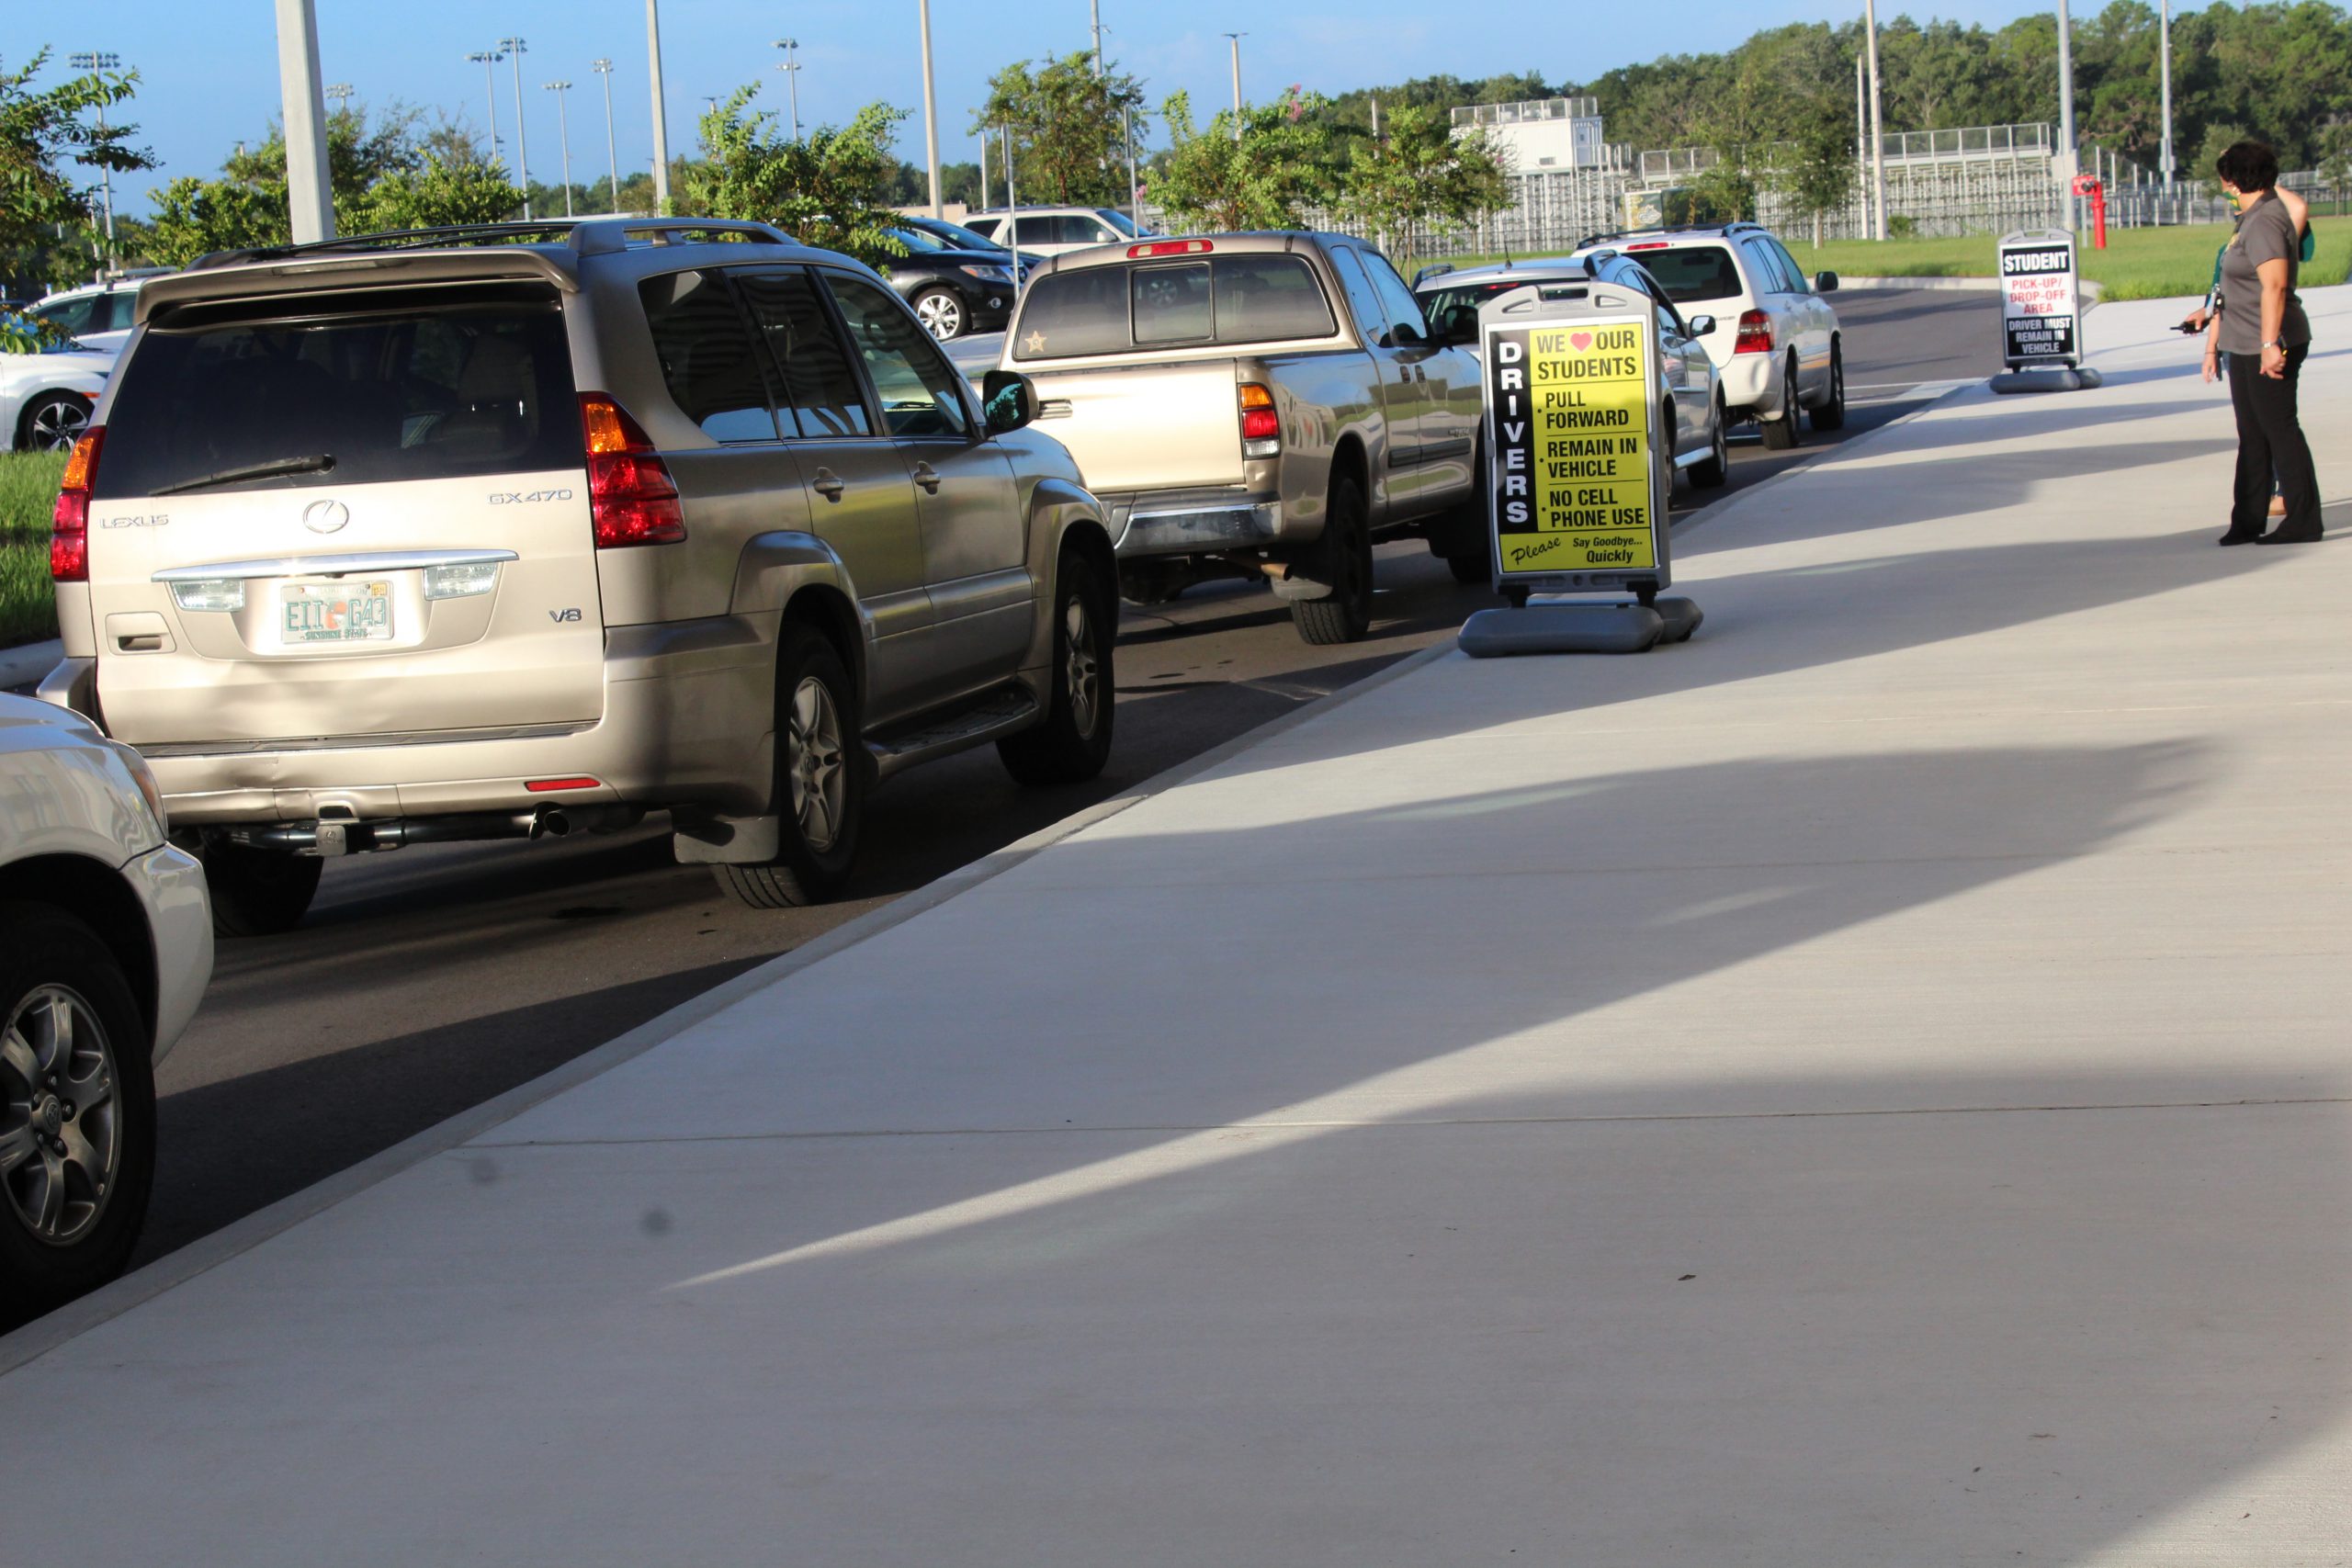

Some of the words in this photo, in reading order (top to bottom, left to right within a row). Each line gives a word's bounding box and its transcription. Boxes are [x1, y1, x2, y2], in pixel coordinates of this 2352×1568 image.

[2004, 252, 2068, 272] STUDENT
[2012, 277, 2062, 289] PICK-UP/
[2010, 289, 2066, 303] DROP-OFF
[2024, 303, 2053, 314] AREA
[2008, 319, 2042, 331] DRIVER
[2044, 317, 2071, 330] MUST
[1536, 334, 1566, 354] WE
[1596, 330, 1635, 350] OUR
[2016, 332, 2052, 343] REMAIN
[2054, 330, 2065, 341] IN
[2022, 343, 2060, 354] VEHICLE
[1537, 356, 1636, 380] STUDENTS
[1545, 390, 1587, 409] PULL
[1546, 409, 1629, 429] FORWARD
[1498, 342, 1529, 524] DRIVERS
[1547, 441, 1613, 458] REMAIN
[1620, 437, 1637, 454] IN
[1548, 459, 1617, 479] VEHICLE
[1549, 490, 1572, 507] NO
[1577, 488, 1618, 505] CELL
[99, 514, 169, 529] LEXUS
[1551, 509, 1607, 528] PHONE
[1611, 508, 1645, 525] USE
[1510, 537, 1562, 566] Please
[1573, 538, 1590, 548] Say
[1593, 536, 1643, 547] Goodbye...
[1587, 550, 1634, 563] Quickly
[548, 607, 582, 623] V8
